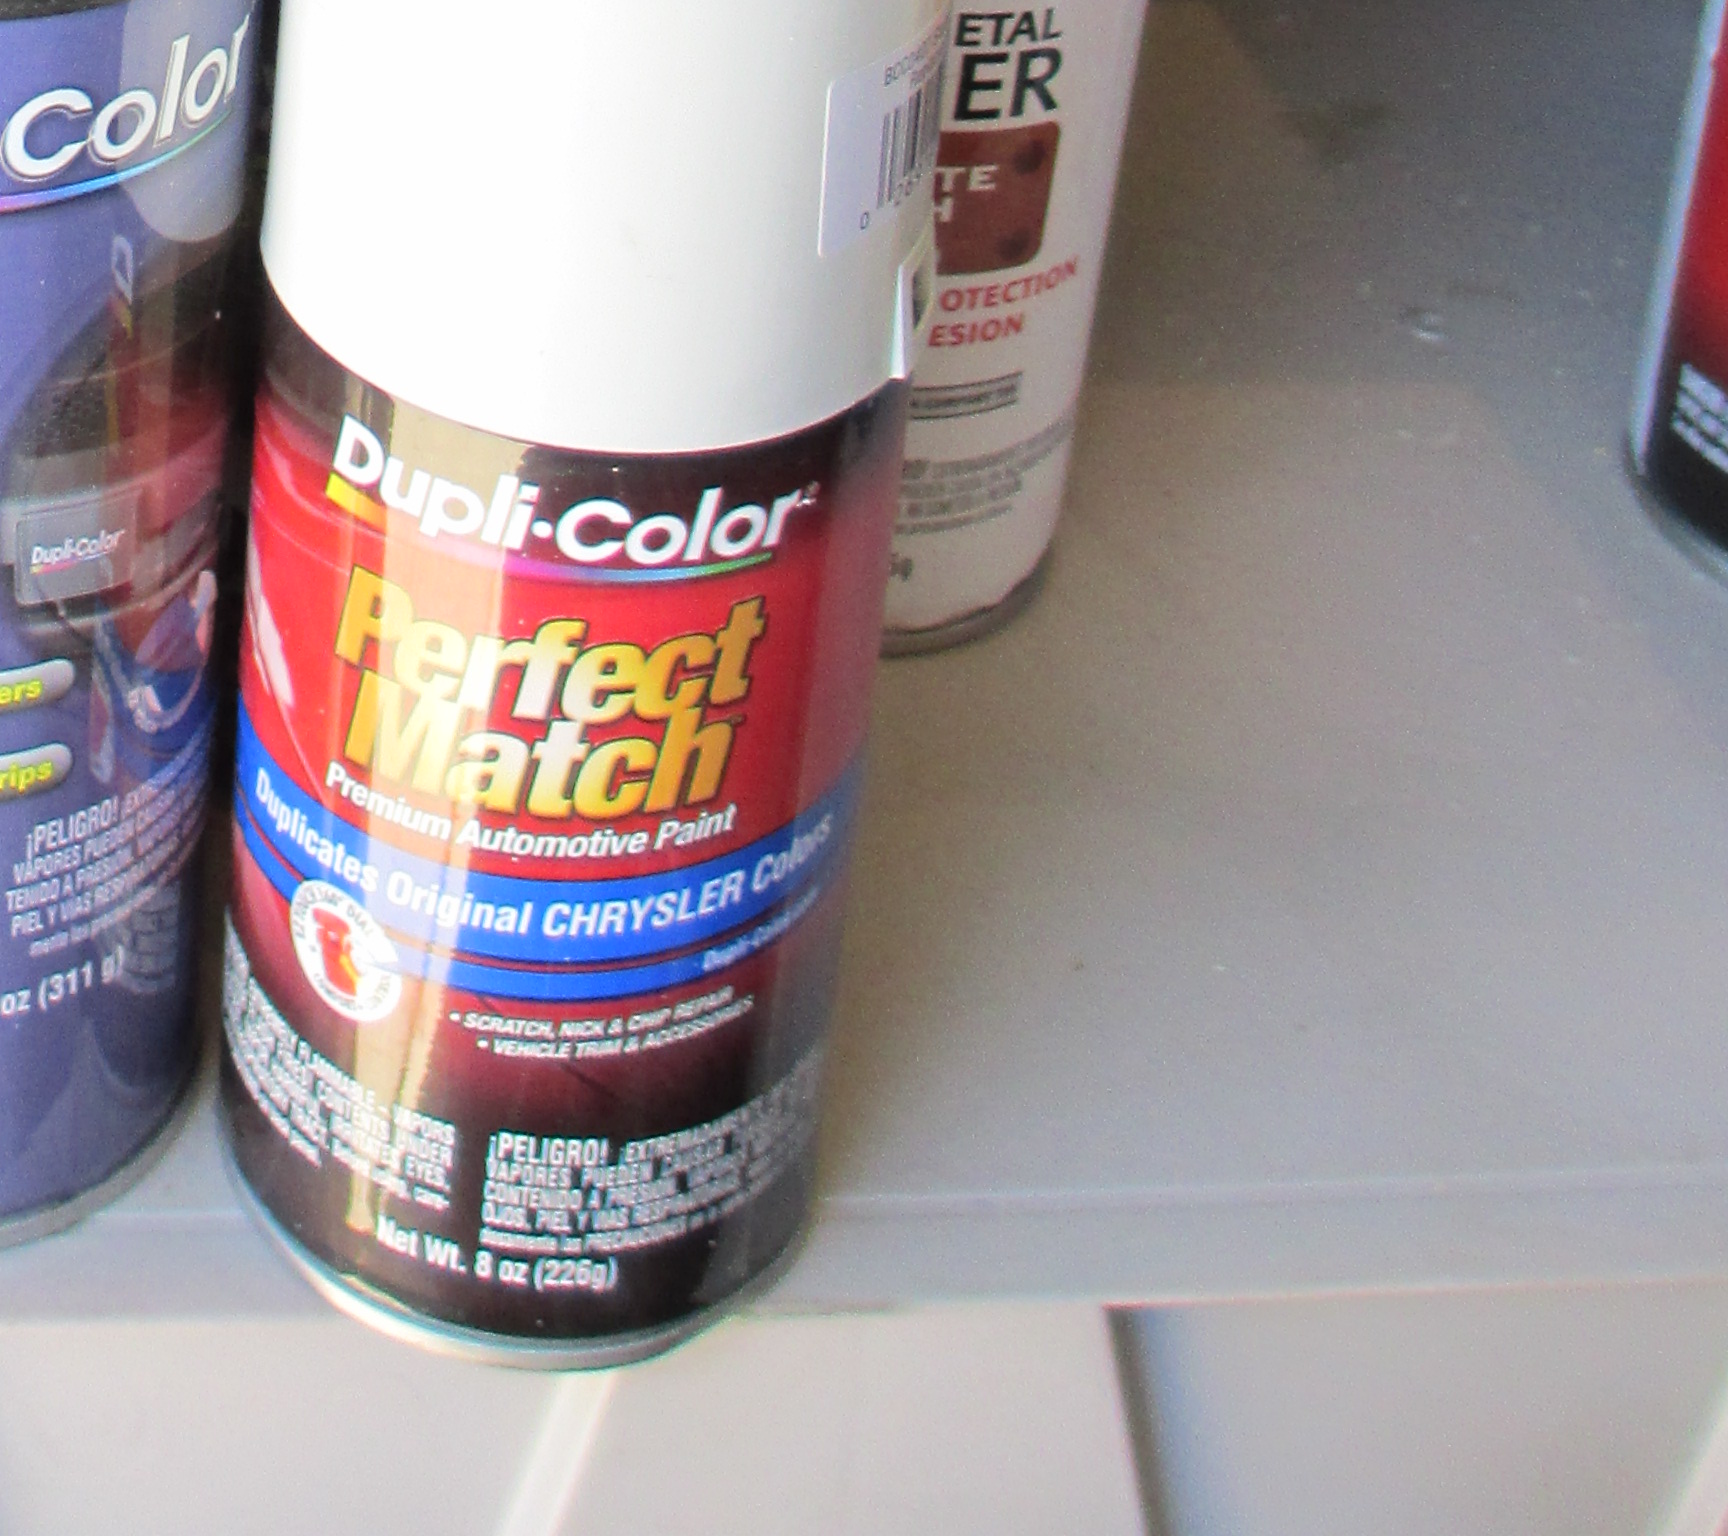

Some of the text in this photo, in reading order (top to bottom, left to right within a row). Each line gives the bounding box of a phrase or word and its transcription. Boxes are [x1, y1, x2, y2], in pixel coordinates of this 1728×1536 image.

[954, 7, 1064, 48] ETAL
[939, 254, 1079, 313] OTECTION
[928, 310, 1024, 348] ESION
[330, 413, 808, 565] Dupli-Color
[30, 529, 126, 565] Dupli-Color
[333, 563, 767, 727] Perfect
[342, 668, 736, 821] Match
[326, 760, 738, 863] Premium Automotive Paint
[12, 844, 83, 885] VAPORES
[254, 766, 380, 891] Duplicates
[385, 869, 534, 940] Original
[542, 866, 745, 939] CHRYSLER
[36, 959, 94, 1013] (311
[463, 1010, 557, 1040] SCRATCH,
[491, 1036, 572, 1059] VEHICLE
[483, 1178, 584, 1211] CONTENIDO
[486, 1155, 574, 1188] VAPORES
[376, 1214, 421, 1260] Net
[423, 1237, 468, 1276] Wt.
[473, 1249, 493, 1280] 8
[497, 1259, 530, 1287] oz
[532, 1256, 620, 1294] (226g)
